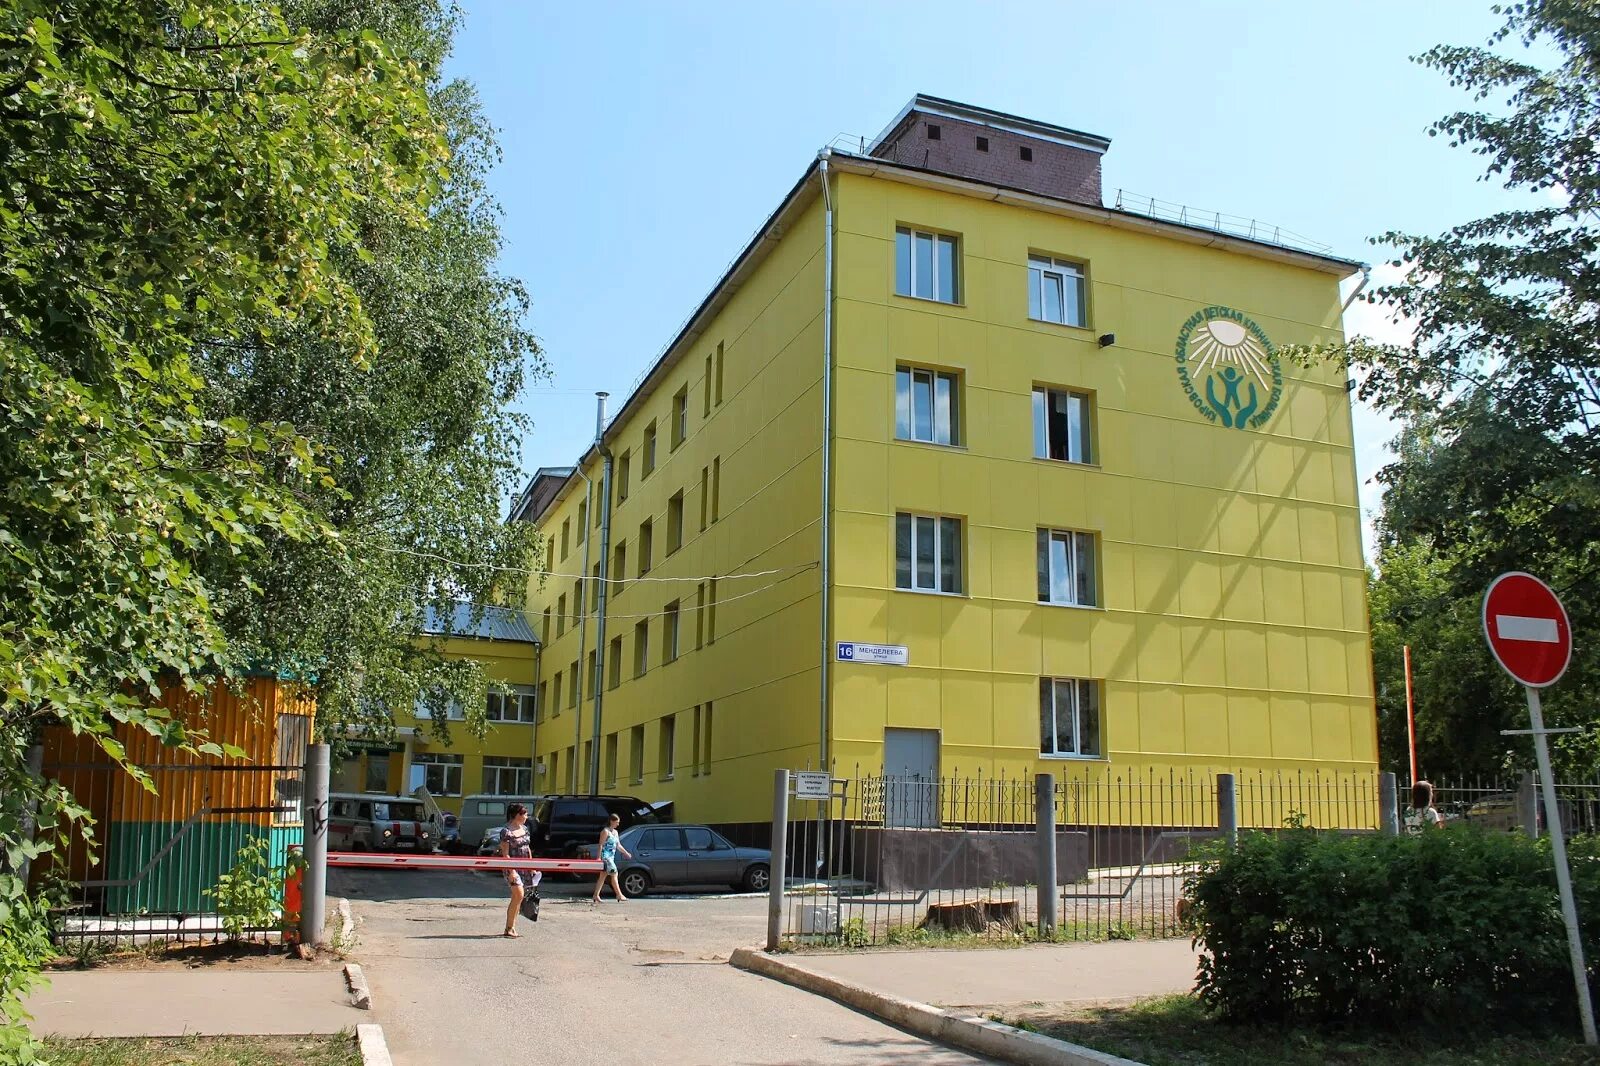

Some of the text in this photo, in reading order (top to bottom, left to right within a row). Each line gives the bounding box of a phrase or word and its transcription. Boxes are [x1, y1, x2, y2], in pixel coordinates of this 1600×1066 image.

[1175, 306, 1283, 428] КИРОВСКАЯ ОБЛАСТНАЯ ДЕТСКАЯ КЛИНИЧСКАЯ БОЛЬНИЦА
[839, 646, 853, 657] 16
[858, 647, 903, 656] МЕНДЕЛЕЕВА
